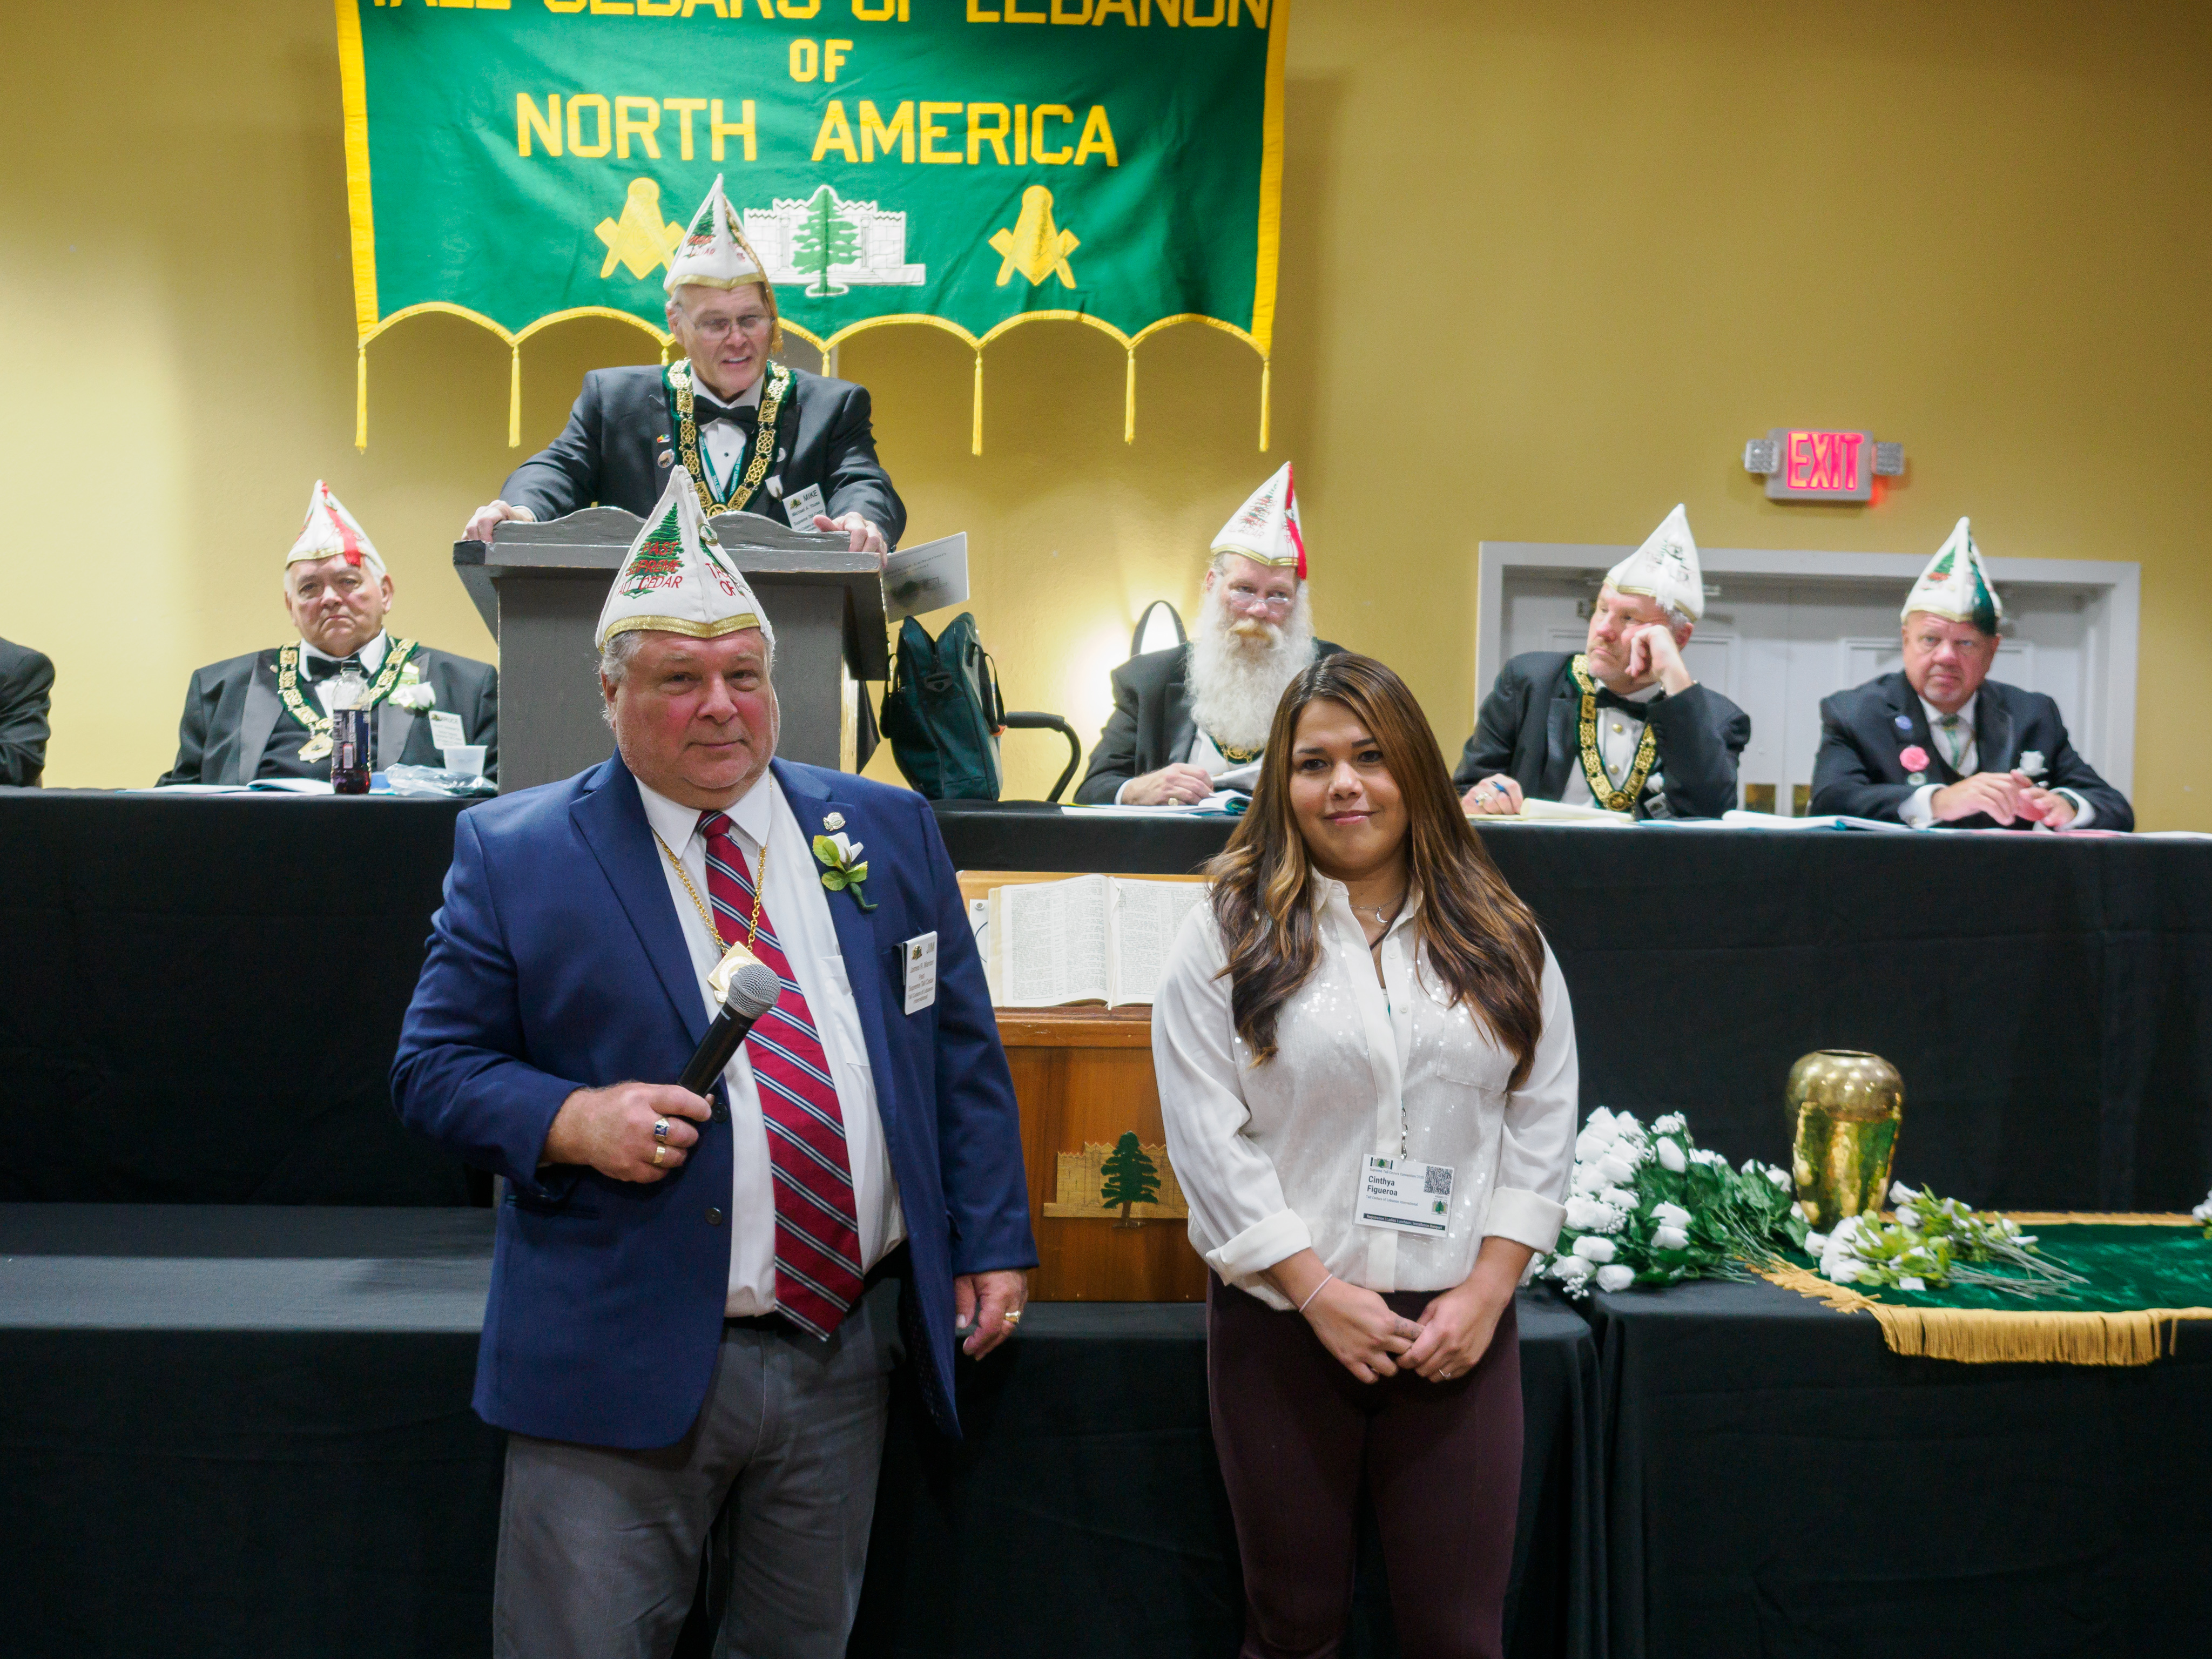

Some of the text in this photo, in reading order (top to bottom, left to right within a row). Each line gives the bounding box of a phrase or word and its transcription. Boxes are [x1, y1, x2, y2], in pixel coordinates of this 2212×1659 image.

[790, 39, 853, 83] OF
[517, 93, 1118, 167] NORTH AMERICA
[1786, 431, 1864, 491] EXIT
[802, 489, 818, 502] MIKE
[640, 541, 678, 556] PAST
[625, 558, 683, 577] SUPREME
[638, 575, 683, 590] CEDAR
[719, 580, 736, 596] OF
[1368, 1175, 1395, 1186] Cinthya
[1367, 1185, 1398, 1196] Figueroa
